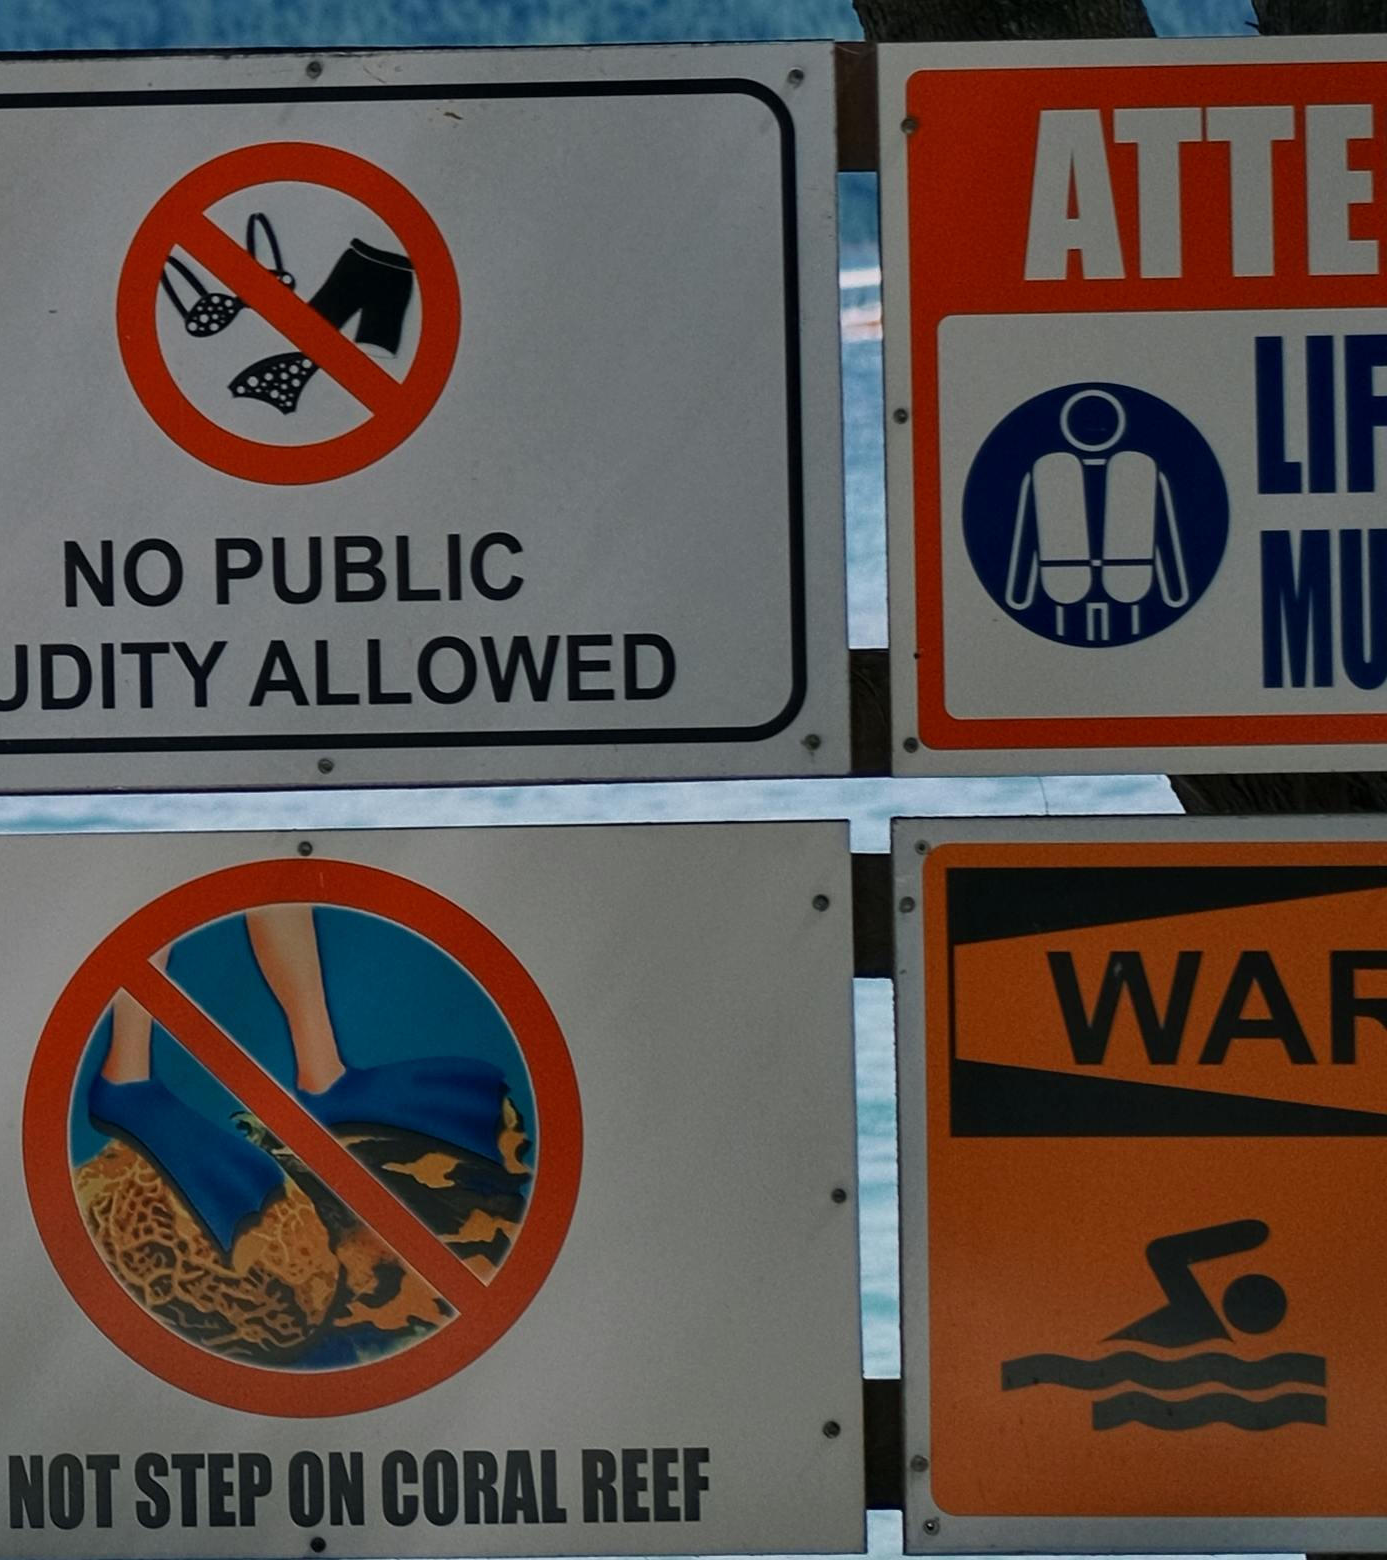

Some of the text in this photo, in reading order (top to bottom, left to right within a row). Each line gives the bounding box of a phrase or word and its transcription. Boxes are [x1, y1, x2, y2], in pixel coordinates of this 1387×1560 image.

[1024, 103, 1380, 281] ATTE
[63, 531, 525, 608] NO PUBLIC
[1260, 528, 1387, 691] MU
[248, 633, 677, 707] ALLOWED
[1046, 949, 1387, 1066] WAR
[8, 1452, 121, 1531] NOT
[134, 1452, 273, 1530] STEP
[288, 1450, 366, 1529] ON
[381, 1449, 568, 1527] CORAL
[581, 1447, 710, 1524] REEF
